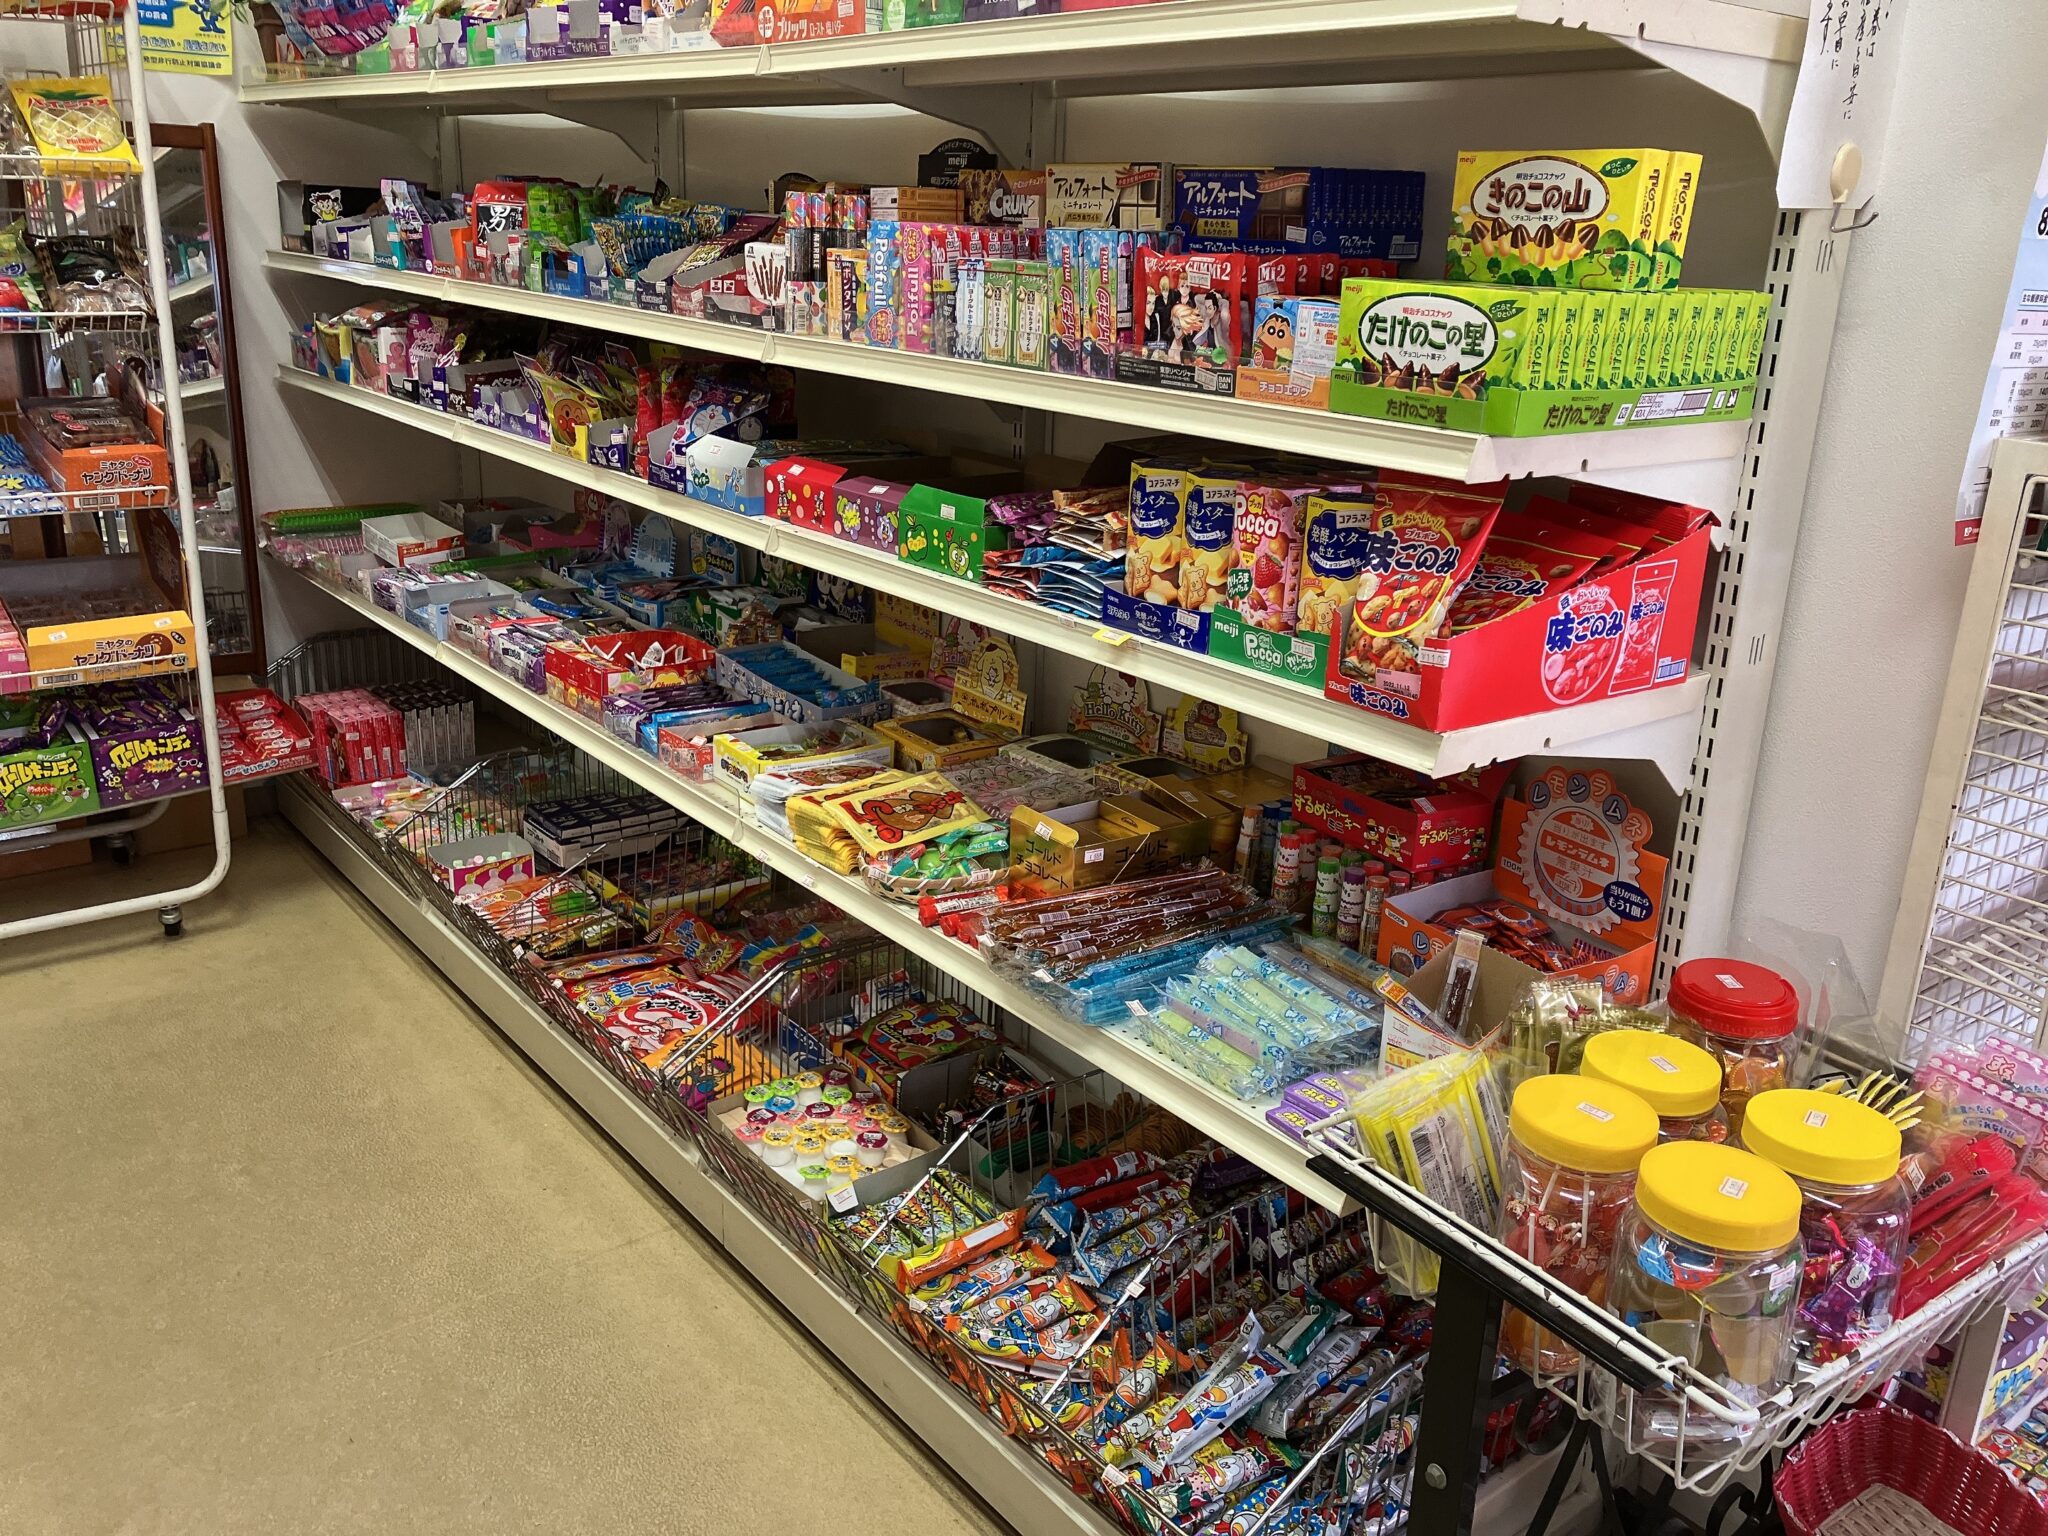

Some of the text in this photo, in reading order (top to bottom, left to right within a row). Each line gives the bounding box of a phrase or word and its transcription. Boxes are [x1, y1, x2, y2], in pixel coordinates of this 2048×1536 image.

[777, 18, 807, 40] プリッツ
[948, 154, 968, 168] meiji
[1459, 155, 1477, 164] meiji
[1053, 175, 1115, 199] アルフォート
[1516, 172, 1566, 181] 明治チョコスナック
[1183, 180, 1256, 205] アルフォート
[1486, 177, 1591, 214] きのこの山
[1062, 200, 1104, 210] ミニチョコレート
[1193, 206, 1242, 217] ミニチョコレート
[1640, 168, 1660, 241] きのこの山
[1669, 171, 1692, 243] きのこの山
[812, 232, 821, 269] MARBLE
[1204, 241, 1242, 253] アルフォート
[1243, 246, 1287, 255] ミニチョコレート
[1339, 235, 1376, 248] アルフォート
[874, 237, 889, 306] Poifull
[1063, 247, 1071, 282] mini
[1101, 247, 1109, 284] mini
[1656, 260, 1664, 284] meiji
[906, 266, 919, 336] Poifull
[1345, 285, 1363, 295] meiji
[1402, 307, 1453, 318] 明治チョコスナック
[1366, 313, 1488, 357] たけのこの里
[1218, 374, 1231, 383] BAN
[1218, 383, 1229, 392] DAI
[1334, 373, 1352, 384] meiji
[1386, 399, 1448, 424] たけのこの里
[1544, 402, 1614, 428] たけのこの里
[101, 460, 133, 469] ミヤタの
[82, 468, 151, 485] ヤングドーナツ
[1148, 478, 1180, 488] コアラのマーチ
[1310, 501, 1324, 509] LOTTE
[1239, 532, 1260, 544] いちご
[1311, 525, 1368, 544] 発酵バター
[1404, 528, 1440, 541] ブルボン
[1319, 547, 1345, 558] 仕立て
[1364, 531, 1460, 574] 味ごのみ
[1580, 602, 1605, 613] ブルボン
[1630, 602, 1665, 621] 味ごのみ
[1214, 621, 1239, 638] meiji
[1546, 611, 1624, 652] 味ごのみ
[73, 644, 155, 666] ヤングドーナツ
[96, 639, 133, 650] ミヤタの
[1328, 680, 1349, 693] ブルボン
[1350, 684, 1409, 717] 味ごのみ
[1084, 702, 1146, 737] Hello Kitty
[109, 735, 192, 770] ロールキャンディ
[1533, 775, 1642, 837] レモンラムネ
[1025, 839, 1062, 864] ゴールド
[1115, 838, 1169, 865] ゴールド
[1545, 835, 1611, 868] レモンラムネ
[1016, 853, 1069, 890] チョコレート
[1556, 856, 1593, 879] 無果汁
[1609, 883, 1650, 907] 当りが出たら
[1608, 896, 1647, 919] もう1個!
